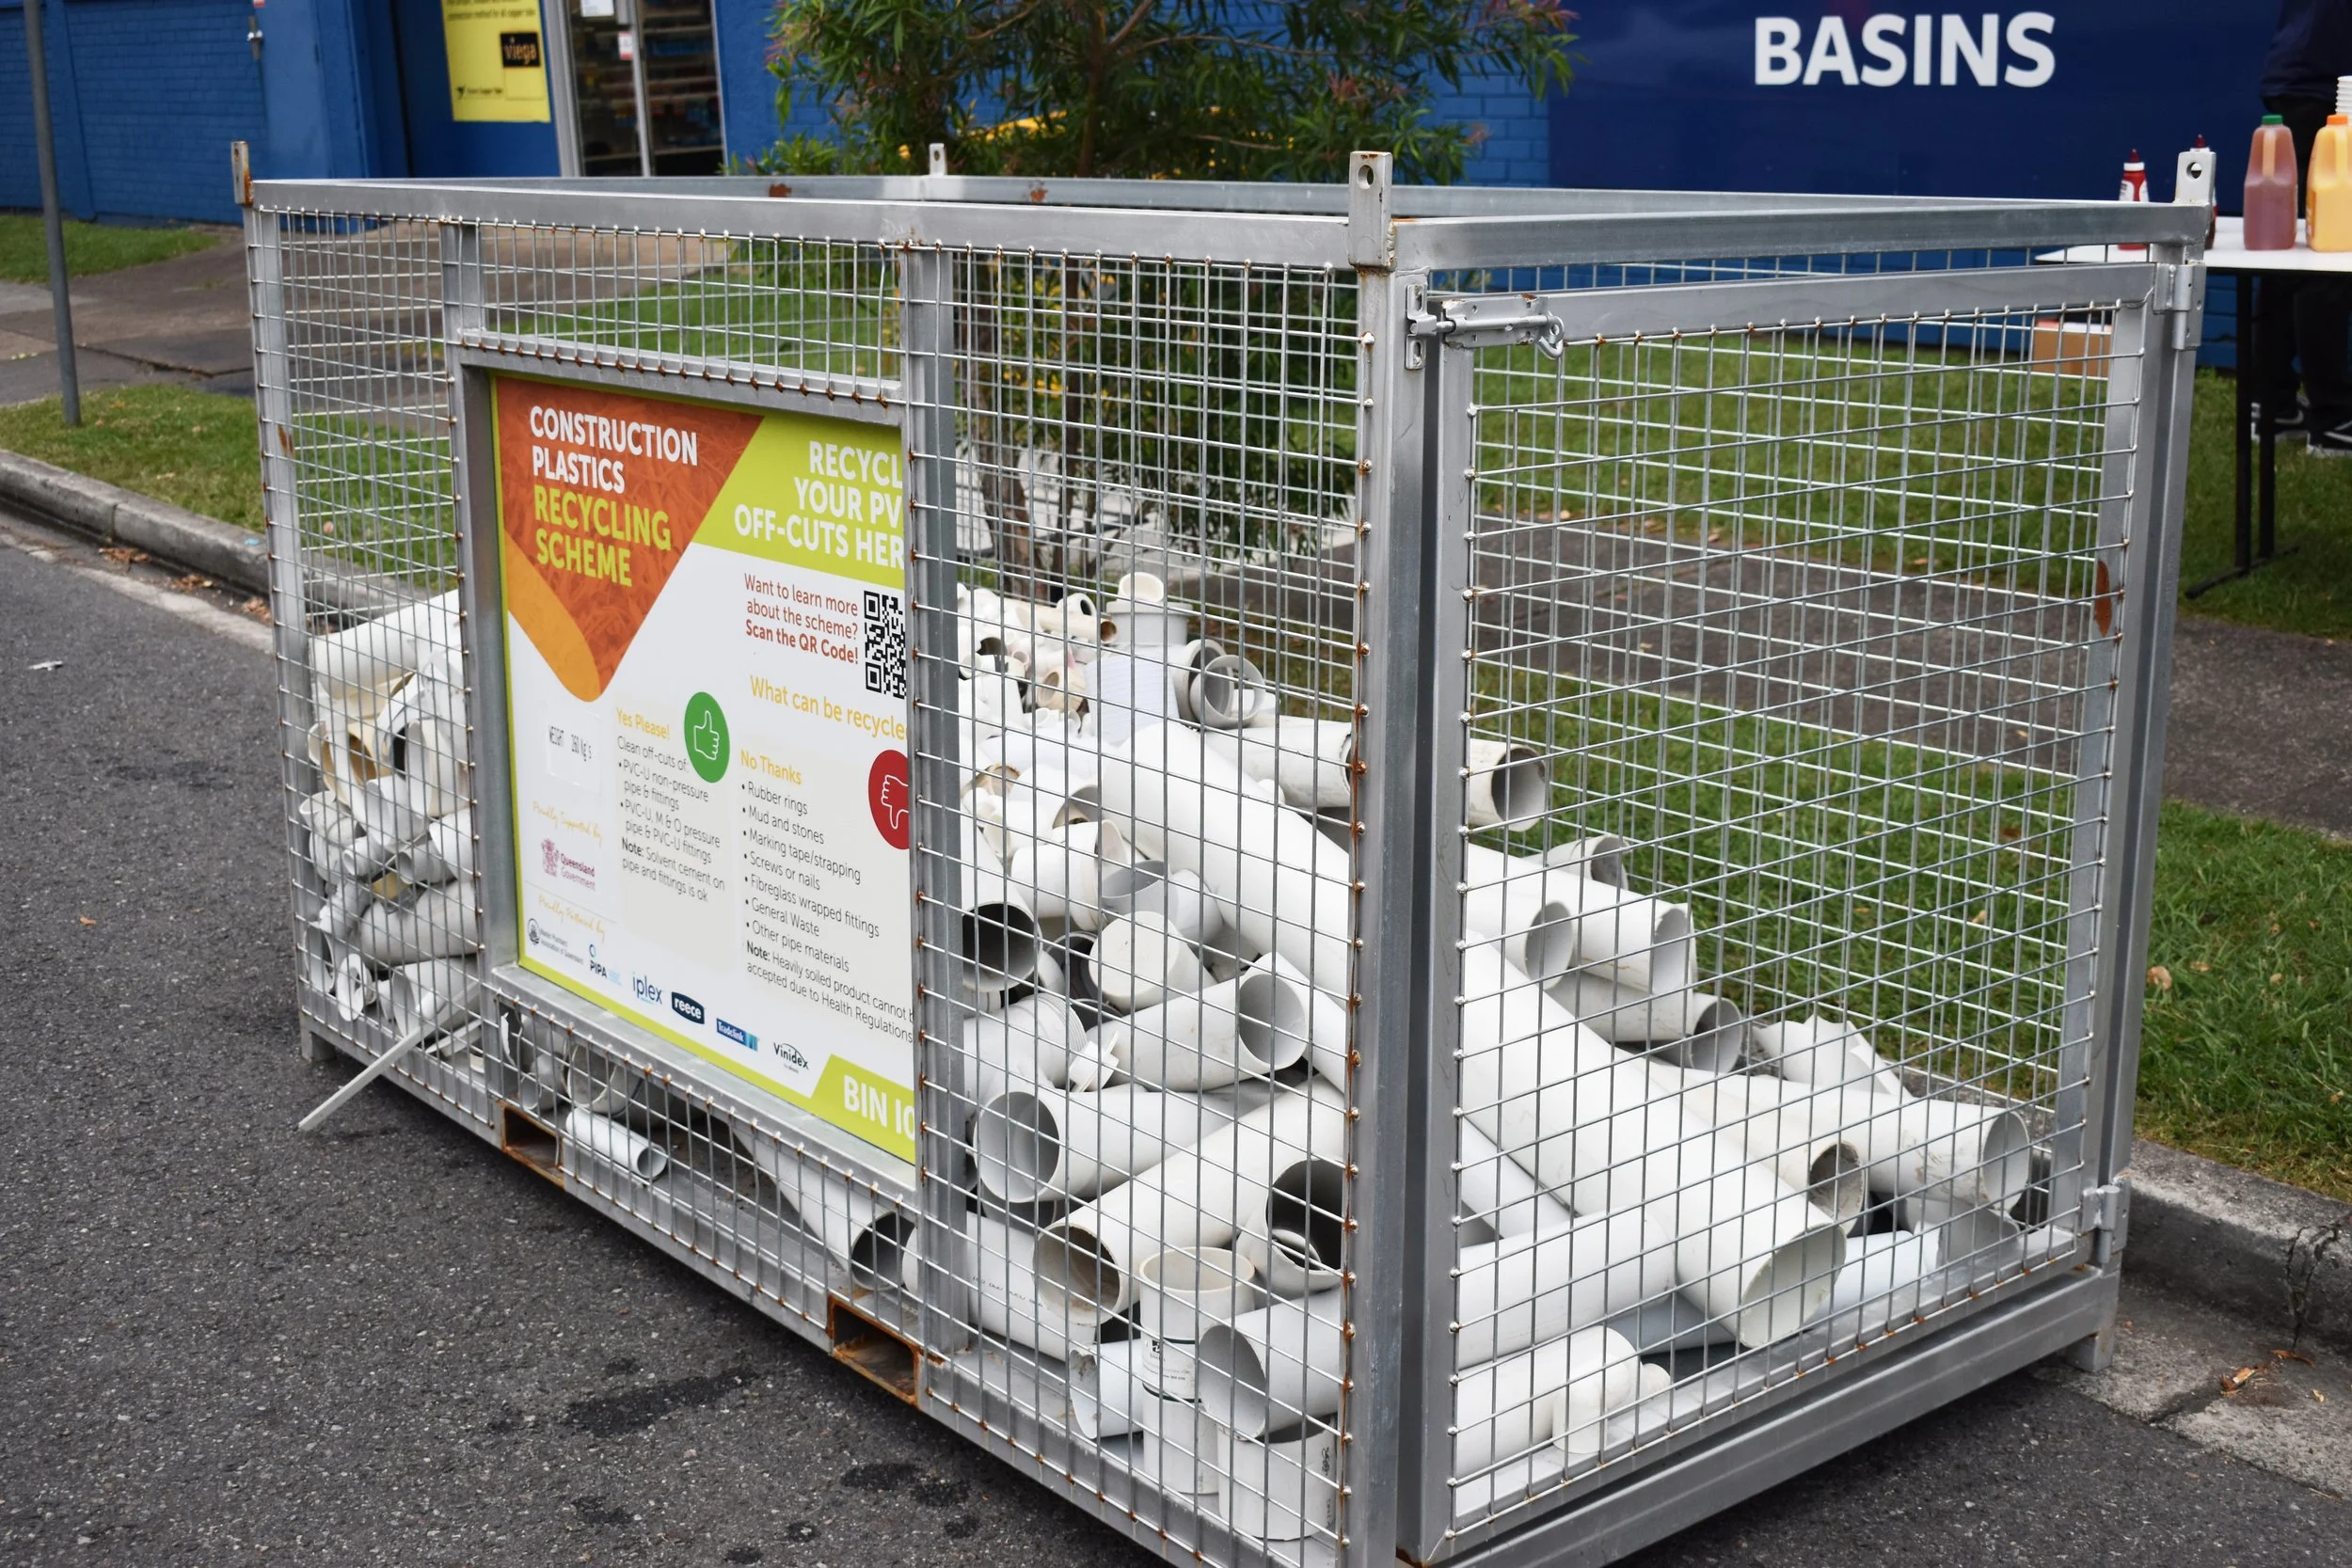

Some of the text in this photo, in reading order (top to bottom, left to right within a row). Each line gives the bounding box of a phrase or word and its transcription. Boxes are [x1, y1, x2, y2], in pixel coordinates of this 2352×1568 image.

[503, 37, 537, 65] viega
[1755, 11, 2056, 88] BASINS
[530, 405, 698, 467] CONSTRUCTION
[532, 445, 626, 495] PLASTICS
[809, 440, 903, 490] RECYCL
[533, 484, 672, 551] RECYCLING
[793, 476, 902, 530] YOUR PV
[535, 528, 633, 587] SCHEME
[734, 503, 905, 571] OFF-CUTS HER
[744, 572, 858, 617] Want to learn more
[745, 619, 859, 664] Scan the QR Code!
[746, 598, 858, 641] about the scheme?
[616, 707, 671, 741] Yes Please!
[750, 674, 908, 741] What can be recycle
[617, 735, 641, 755] Clean
[642, 746, 675, 768] off-cuts
[740, 749, 803, 785] No Thanks
[623, 758, 708, 802] PVC-U non-pressure
[624, 780, 679, 812] pipe & fittings
[748, 781, 808, 816] Rubber rings
[626, 819, 712, 865] pipe & PVC-U fittings
[656, 810, 663, 825] M
[665, 814, 672, 829] &
[674, 817, 682, 833] O
[684, 825, 721, 848] pressure
[749, 804, 825, 846] Mud and stones
[560, 852, 596, 878] Queensland
[561, 866, 596, 891] Government
[621, 836, 725, 892] Note: Solvent cement on
[749, 828, 862, 886] Marking tape/strapping
[750, 850, 820, 891] Screws or nails
[622, 857, 708, 903] pipe and fittings is ok
[750, 873, 881, 940] Fibreglass wrapped fittings
[751, 896, 820, 937] General Waste
[752, 919, 850, 973] Other pipe materials
[589, 959, 608, 979] PIPA
[631, 972, 663, 1005] iplex
[746, 940, 771, 962] Note:
[772, 950, 803, 979] Heavily
[805, 964, 832, 989] soiled
[834, 979, 871, 1006] product
[872, 993, 907, 1021] cannot
[674, 996, 702, 1020] reece
[747, 960, 914, 1044] accepted due to Health Regulations
[773, 1041, 810, 1070] Vinidex
[843, 1073, 888, 1128] BIN
